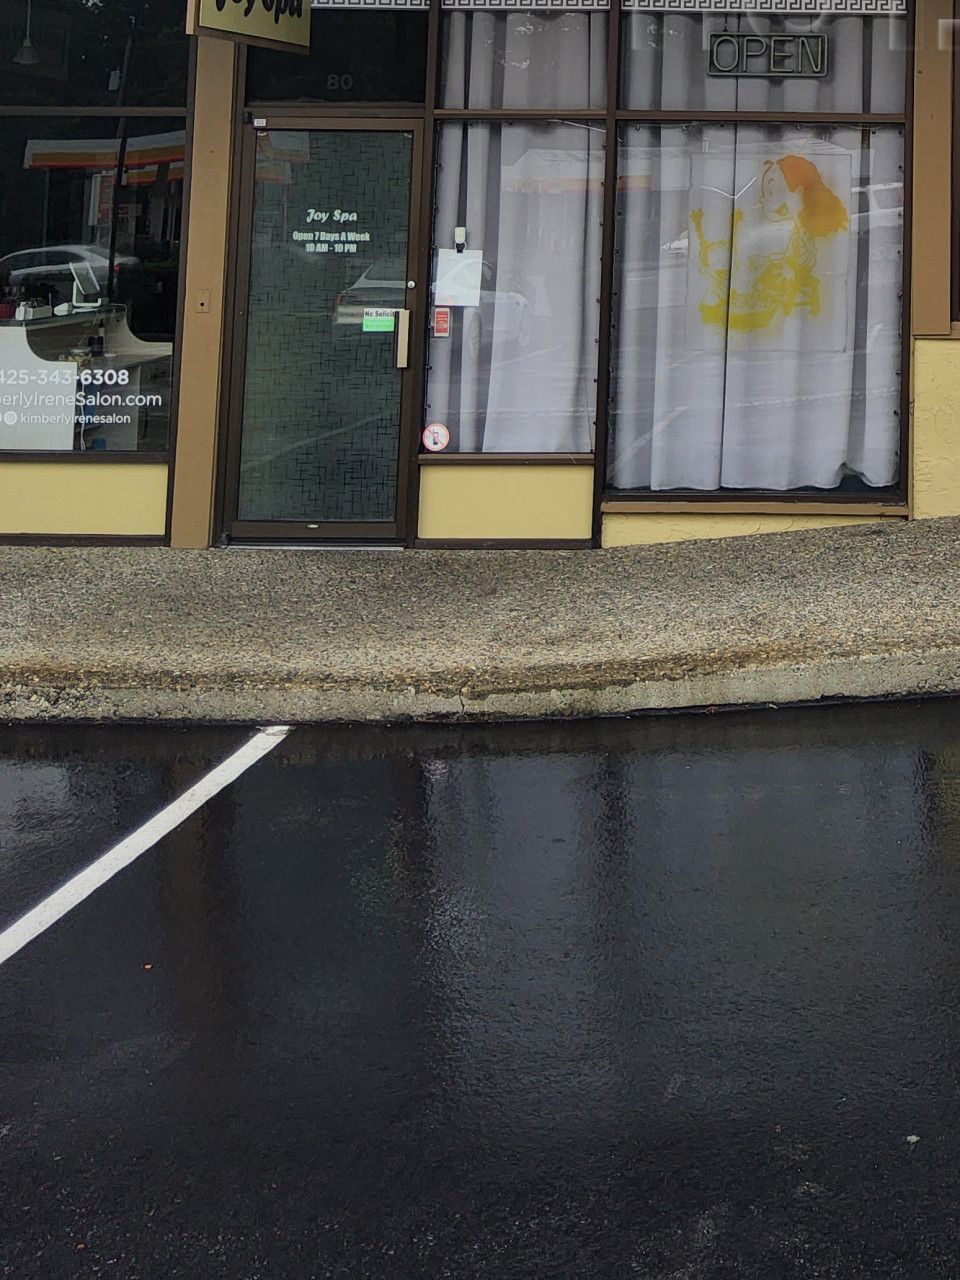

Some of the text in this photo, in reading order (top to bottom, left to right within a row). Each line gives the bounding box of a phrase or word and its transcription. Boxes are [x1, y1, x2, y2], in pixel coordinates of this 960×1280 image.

[712, 35, 823, 73] OPEN
[326, 74, 354, 90] 80
[306, 208, 358, 224] Joy Spa
[292, 231, 371, 241] Open 7 Days A Week
[305, 243, 315, 253] 10
[315, 243, 329, 253] AM
[334, 243, 344, 253] 10
[344, 243, 357, 253] PM
[0, 391, 162, 408] erlyIreneSalon.com
[20, 412, 131, 425] kimberlyirenesalon
